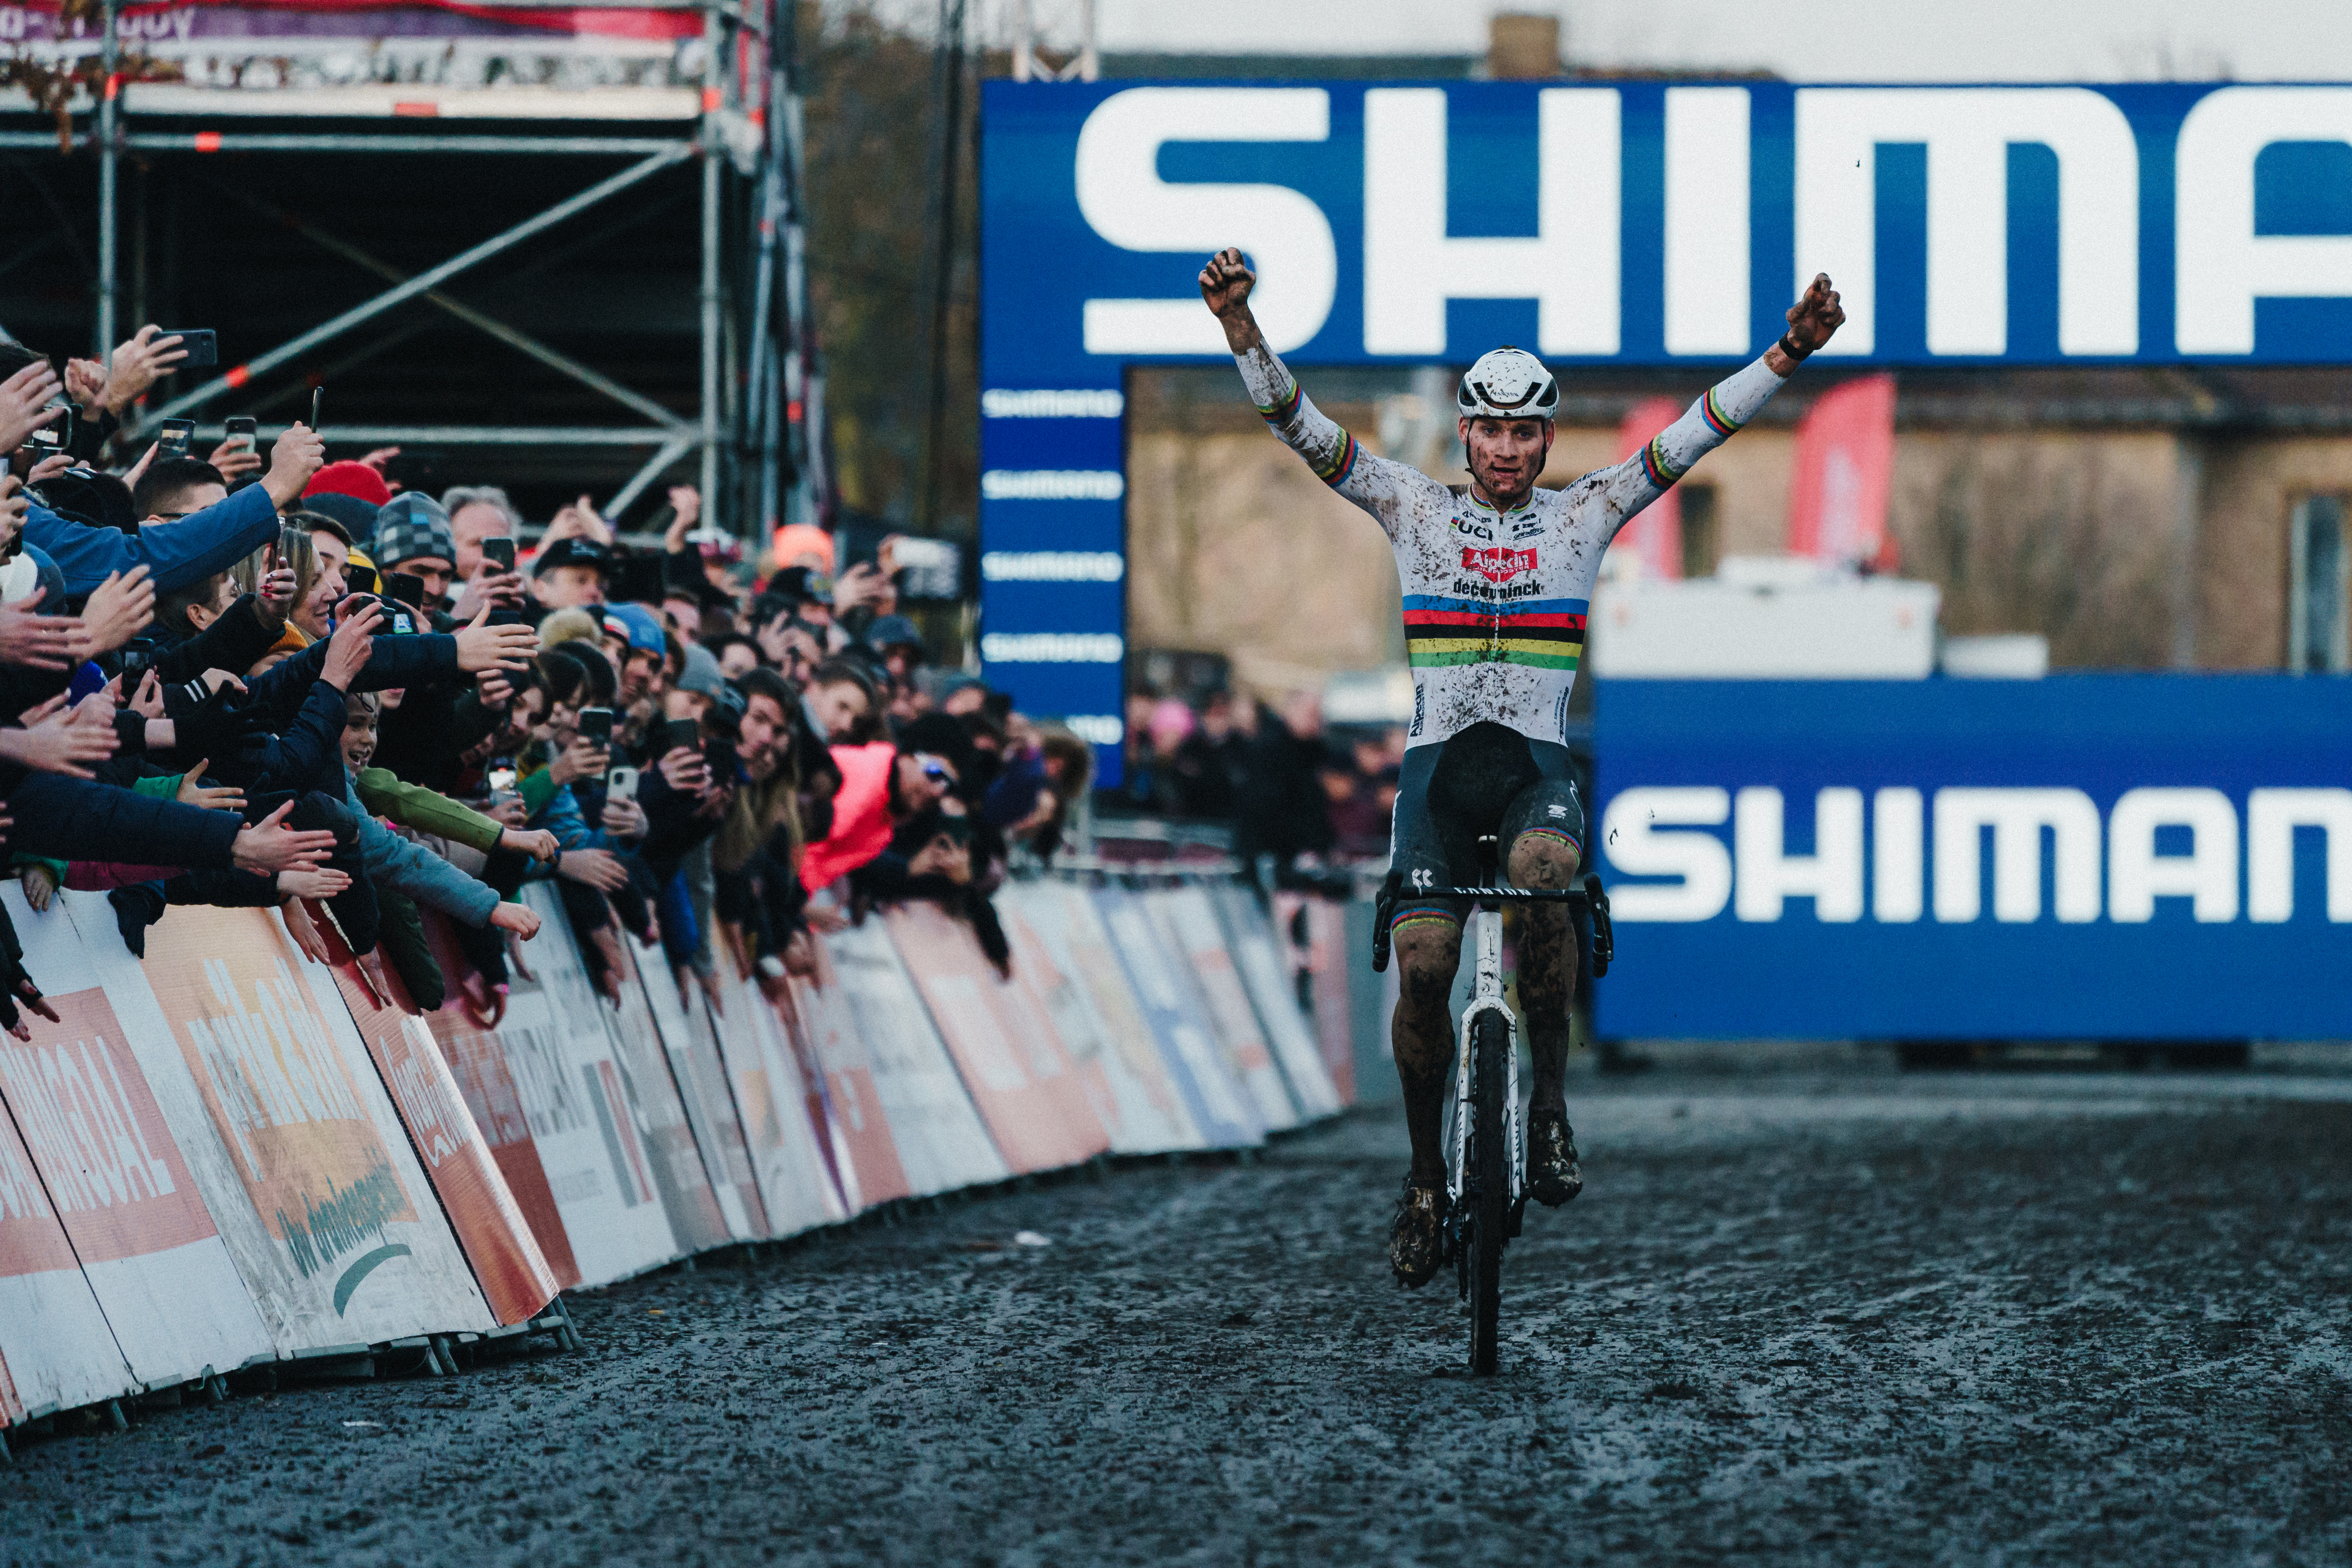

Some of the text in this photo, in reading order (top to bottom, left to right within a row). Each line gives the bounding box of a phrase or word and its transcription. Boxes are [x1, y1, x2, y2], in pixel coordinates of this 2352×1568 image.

[1075, 86, 2352, 357] SHIMA
[1458, 520, 1493, 542] UCI
[1470, 552, 1529, 573] Alpecin
[1410, 685, 1424, 737] Alpecin
[1603, 787, 2352, 922] SHIMAN
